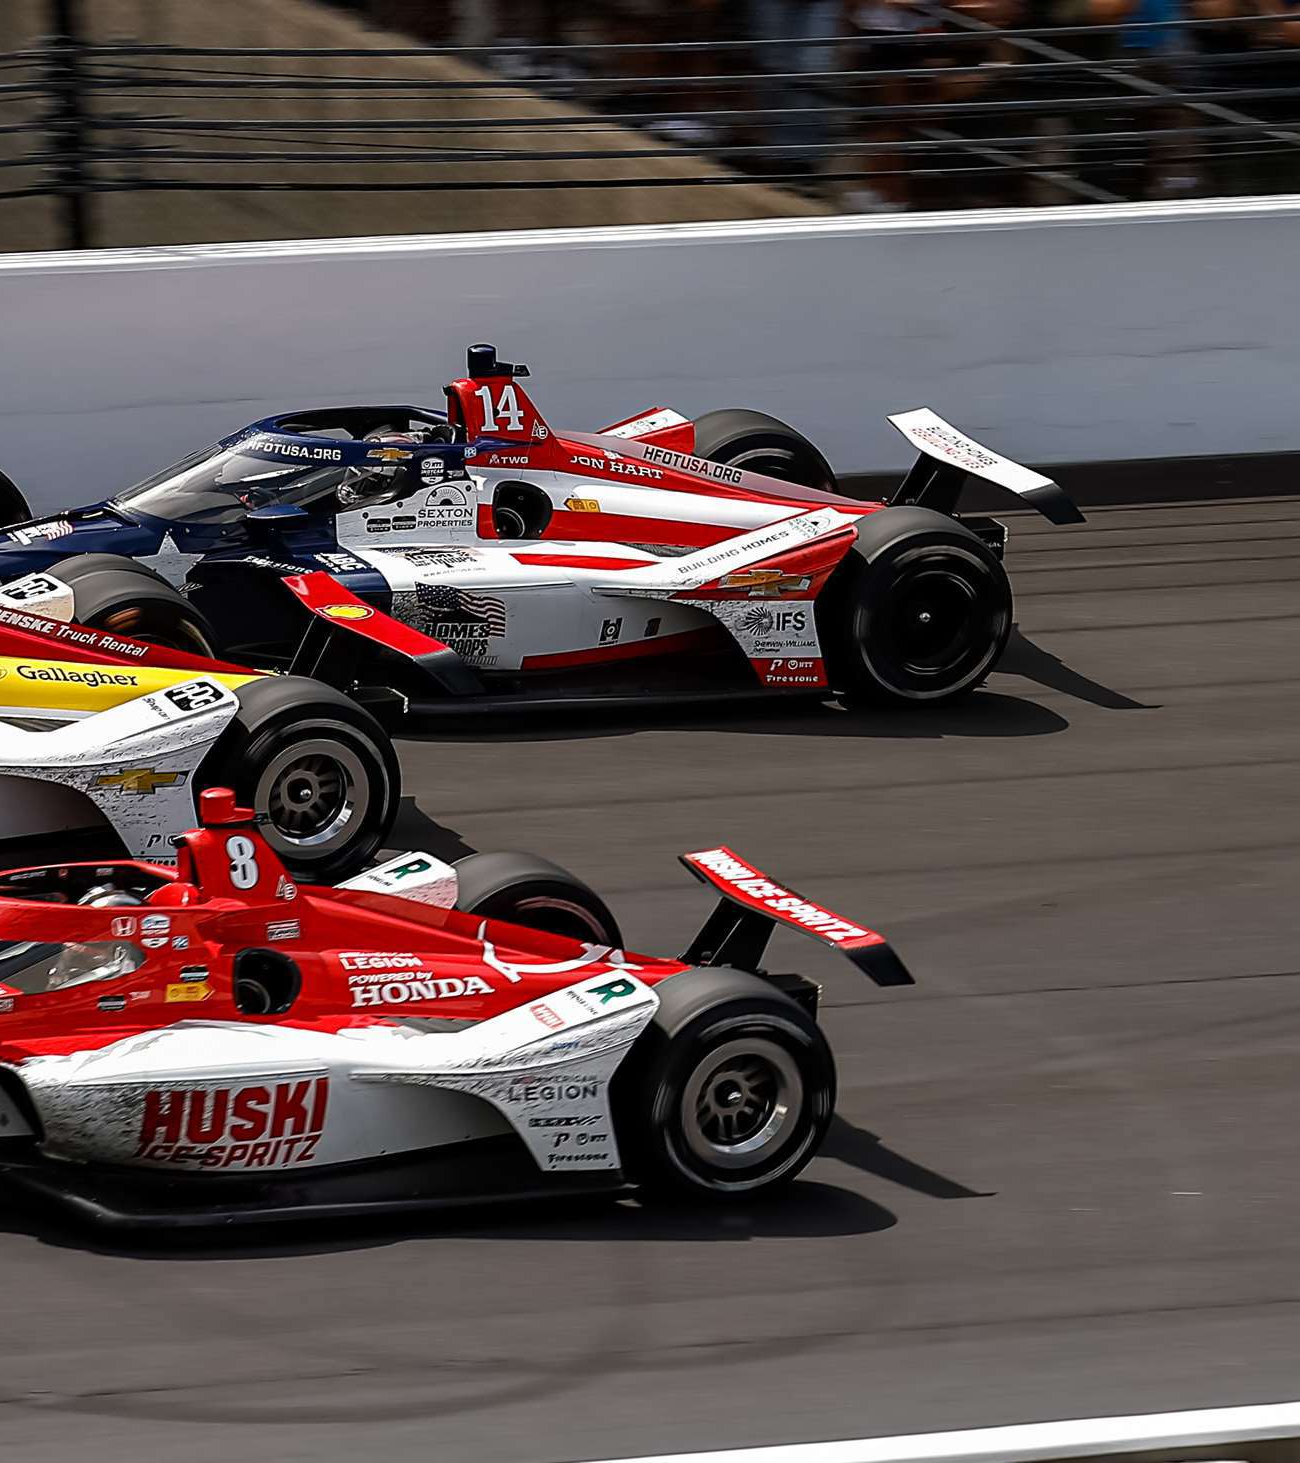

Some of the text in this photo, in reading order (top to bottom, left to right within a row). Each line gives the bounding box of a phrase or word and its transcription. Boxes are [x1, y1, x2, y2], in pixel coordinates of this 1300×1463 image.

[475, 385, 524, 432] 14
[569, 455, 664, 480] JON HART
[643, 446, 743, 484] HFOTUSA.ORG
[417, 508, 474, 519] SEXTON
[417, 519, 474, 528] PROPERTIES
[677, 530, 790, 575] BUILDING HOMES
[775, 611, 807, 631] IFS
[56, 625, 99, 645] Truck
[16, 665, 139, 687] Gallagher
[226, 835, 259, 889] 8
[763, 897, 869, 941] SPRITZ
[339, 957, 423, 970] LEGION
[349, 970, 433, 984] POWERED by
[350, 976, 495, 1007] HONDA
[507, 1085, 598, 1103] LEGION
[137, 1076, 330, 1145] HUSKI
[197, 1133, 323, 1168] SPRITZ
